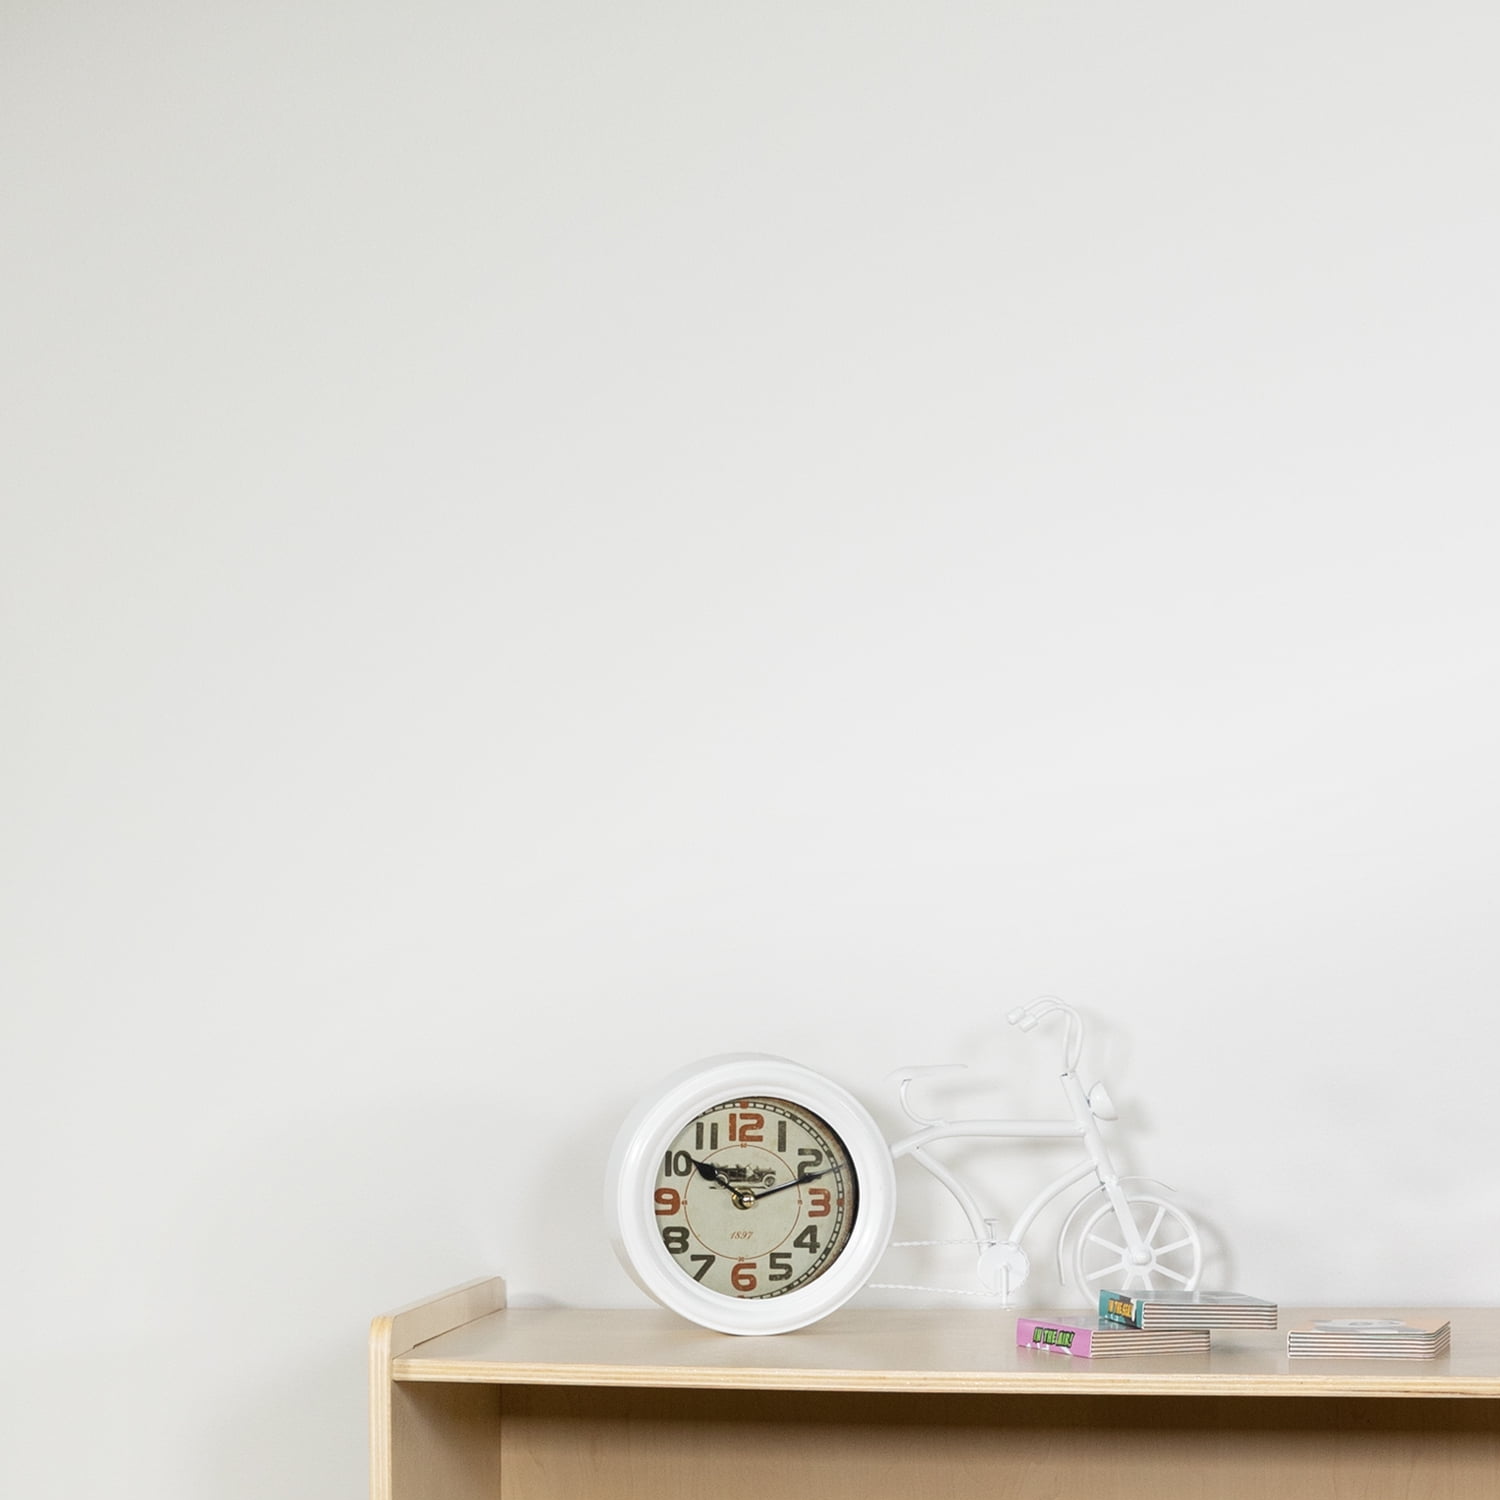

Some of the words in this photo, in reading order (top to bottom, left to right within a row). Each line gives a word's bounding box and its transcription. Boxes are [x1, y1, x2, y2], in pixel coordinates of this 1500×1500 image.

[695, 1122, 718, 1150] 11
[729, 1113, 764, 1142] 12
[778, 1120, 787, 1152] 1
[665, 1150, 693, 1177] 10
[797, 1148, 823, 1180] 2
[654, 1187, 681, 1216] 9
[808, 1188, 831, 1218] 3
[662, 1226, 690, 1255] 8
[730, 1231, 754, 1241] 1897
[793, 1224, 821, 1254] 4
[690, 1254, 716, 1282] 7
[731, 1262, 757, 1292] 6
[768, 1252, 794, 1281] 5
[1033, 1327, 1044, 1343] IN
[1042, 1328, 1057, 1345] THE
[1056, 1330, 1075, 1348] AIR!
